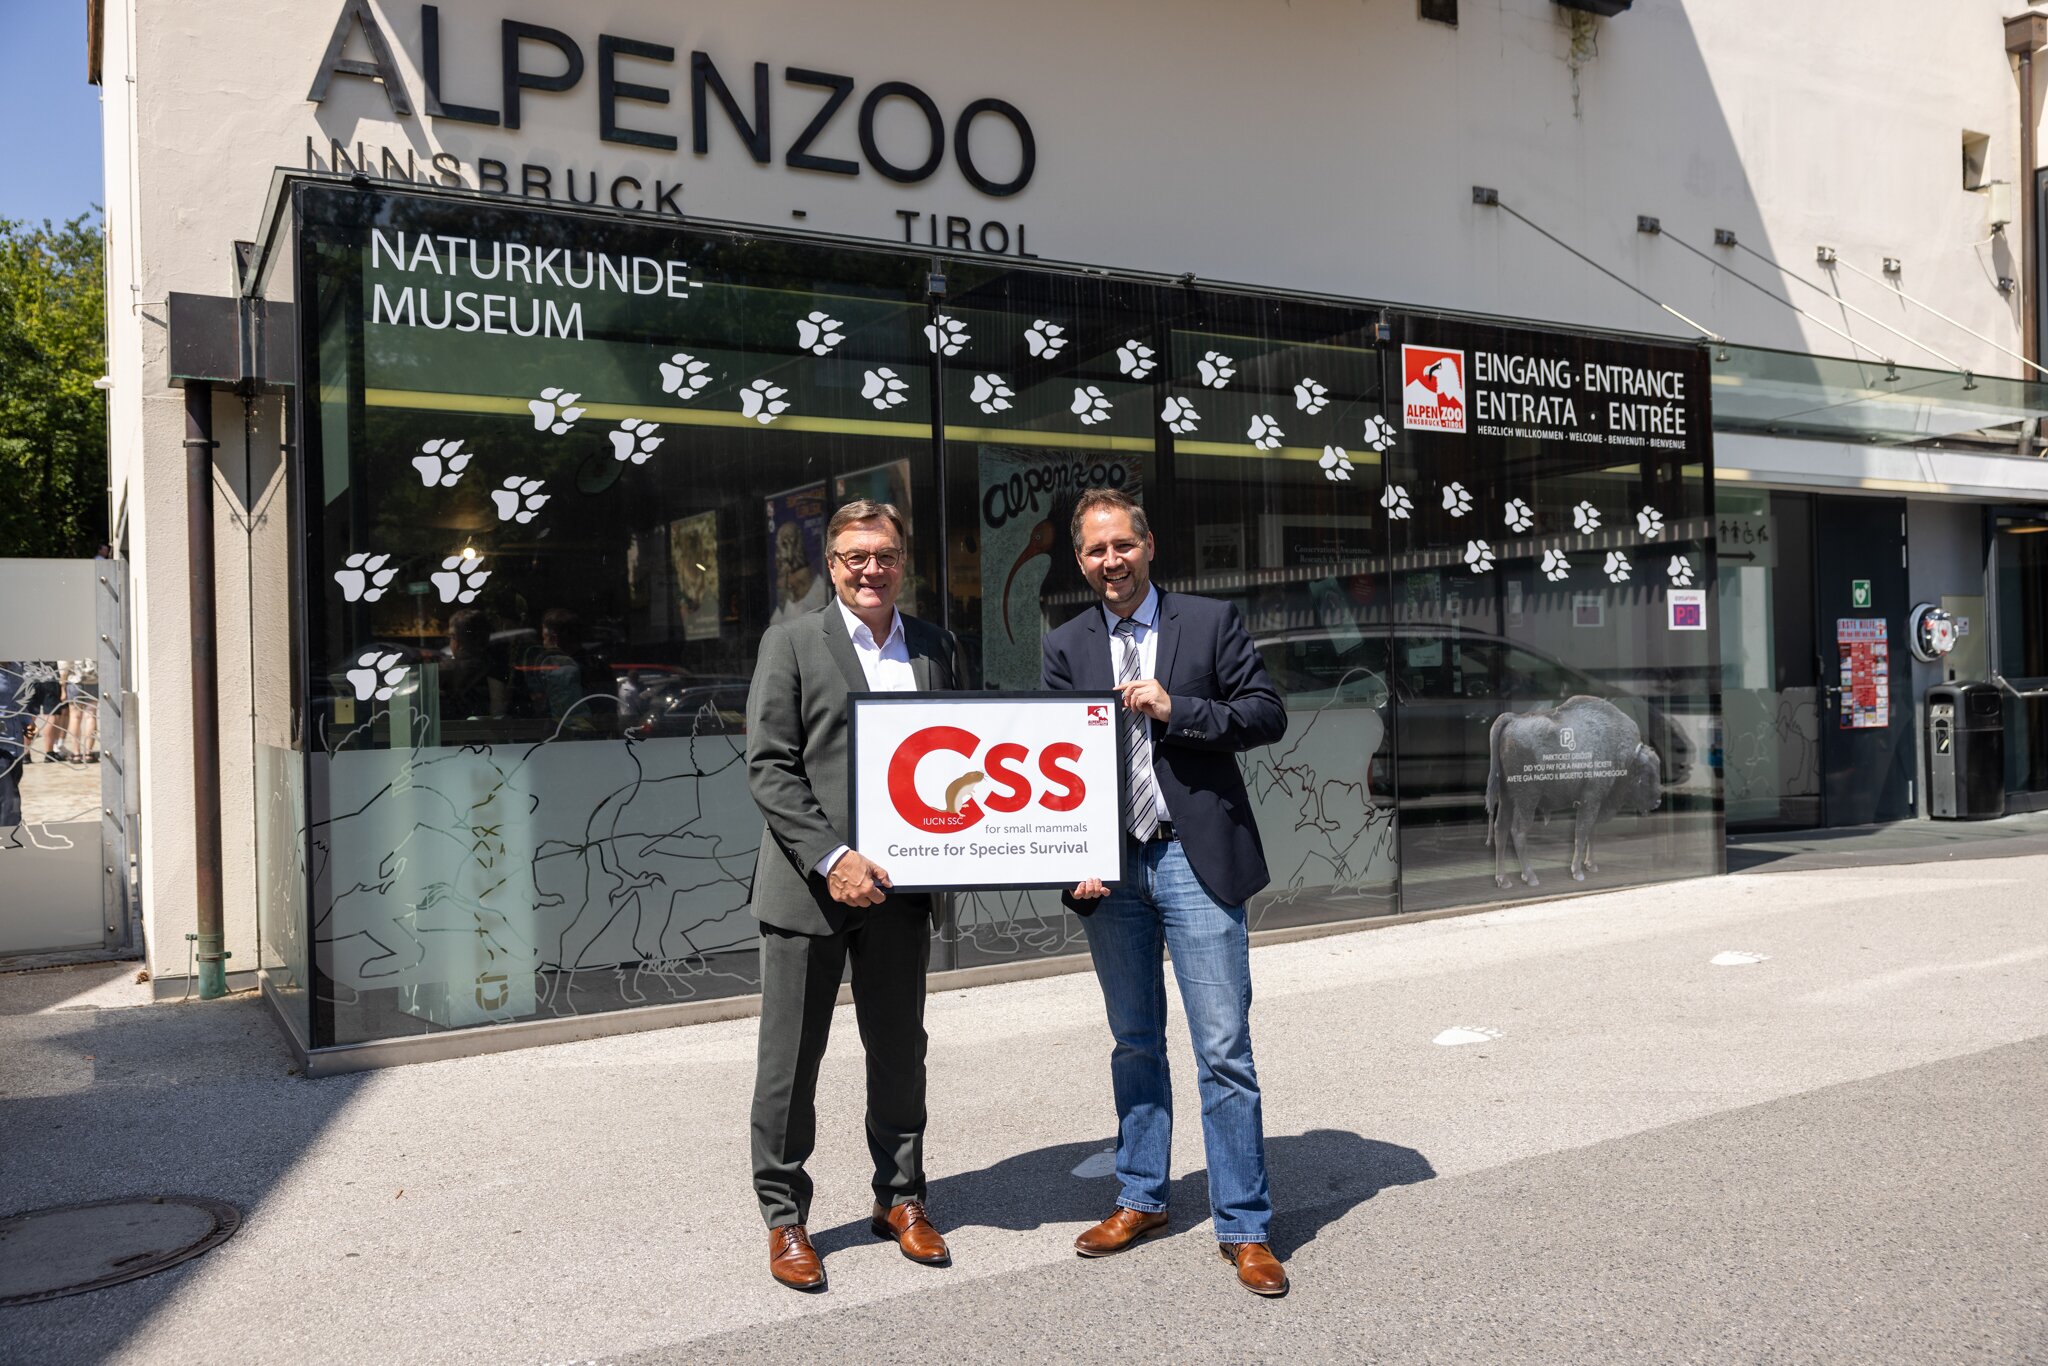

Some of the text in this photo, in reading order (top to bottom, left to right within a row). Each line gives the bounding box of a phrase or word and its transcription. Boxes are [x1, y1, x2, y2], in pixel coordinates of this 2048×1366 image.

[307, 0, 1036, 197] ALPENZOO
[896, 210, 1038, 258] TIROL
[371, 228, 703, 299] NATURKUNDE-
[372, 284, 584, 341] MUSEUM
[1475, 351, 1685, 400] EINGANG ENTRANCE
[1476, 390, 1687, 435] ENTRATA ENTRÉE
[1477, 425, 1686, 450] HERZLICH WILLKOMMEN WELCOME BENVENUTI BIENVENUE
[1506, 775, 1522, 783] AVETE
[1533, 773, 1554, 781] PAGATO
[1523, 764, 1533, 772] DID
[1546, 763, 1555, 771] PAY
[1571, 761, 1593, 769] PARKING
[923, 817, 963, 826] IUCN SSC
[985, 822, 1088, 834] for small mammals
[887, 841, 1088, 858] Centre for Species Survival
